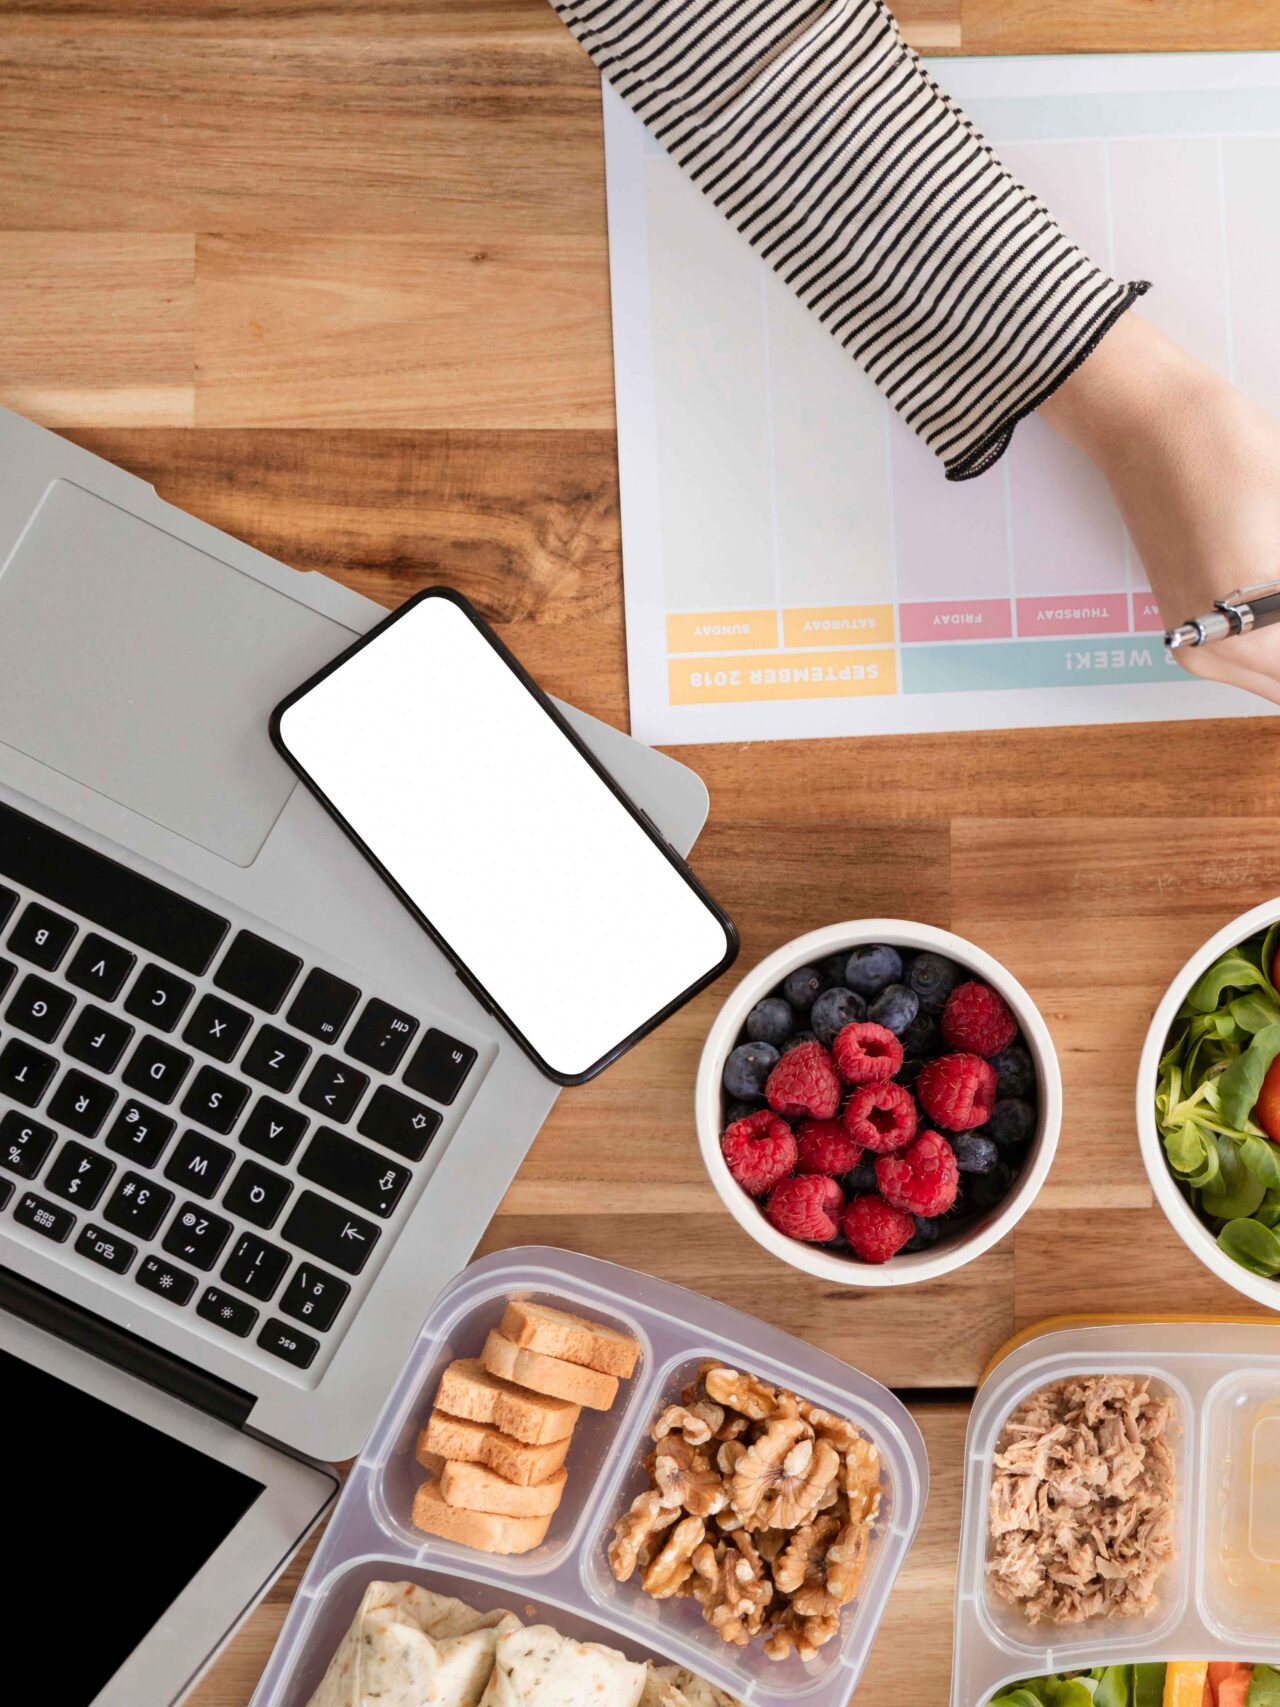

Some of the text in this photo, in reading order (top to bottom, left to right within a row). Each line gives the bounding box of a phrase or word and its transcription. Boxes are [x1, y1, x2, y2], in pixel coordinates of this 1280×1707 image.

[932, 613, 983, 625] FRIDAY
[1036, 607, 1110, 621] THURSDAY
[693, 623, 750, 636] SUNDAY
[803, 618, 876, 631] SATURDAY
[1065, 648, 1153, 671] WEEK!
[689, 664, 879, 688] SEPTEMBER 2018
[35, 929, 49, 946] B
[91, 960, 105, 977] V
[151, 990, 167, 1006] C
[31, 1001, 48, 1017] G
[209, 1019, 227, 1038] X
[390, 1019, 409, 1033] ctrl
[91, 1033, 106, 1048] F
[268, 1050, 285, 1068] Z
[452, 1050, 463, 1064] fn
[15, 1066, 28, 1082] T
[150, 1062, 166, 1080] D
[74, 1095, 90, 1113] R
[208, 1092, 223, 1108] S
[18, 1128, 32, 1144] 5
[133, 1126, 148, 1143] E
[269, 1121, 284, 1138] A
[8, 1146, 22, 1163] %
[78, 1159, 91, 1173] 4
[188, 1156, 208, 1176] W
[68, 1178, 81, 1193] $
[122, 1182, 136, 1196] #
[137, 1189, 150, 1205] 3
[250, 1185, 265, 1203] Q
[182, 1212, 196, 1226] @
[195, 1219, 209, 1235] 2
[255, 1251, 265, 1266] 1
[278, 1336, 297, 1350] esc
